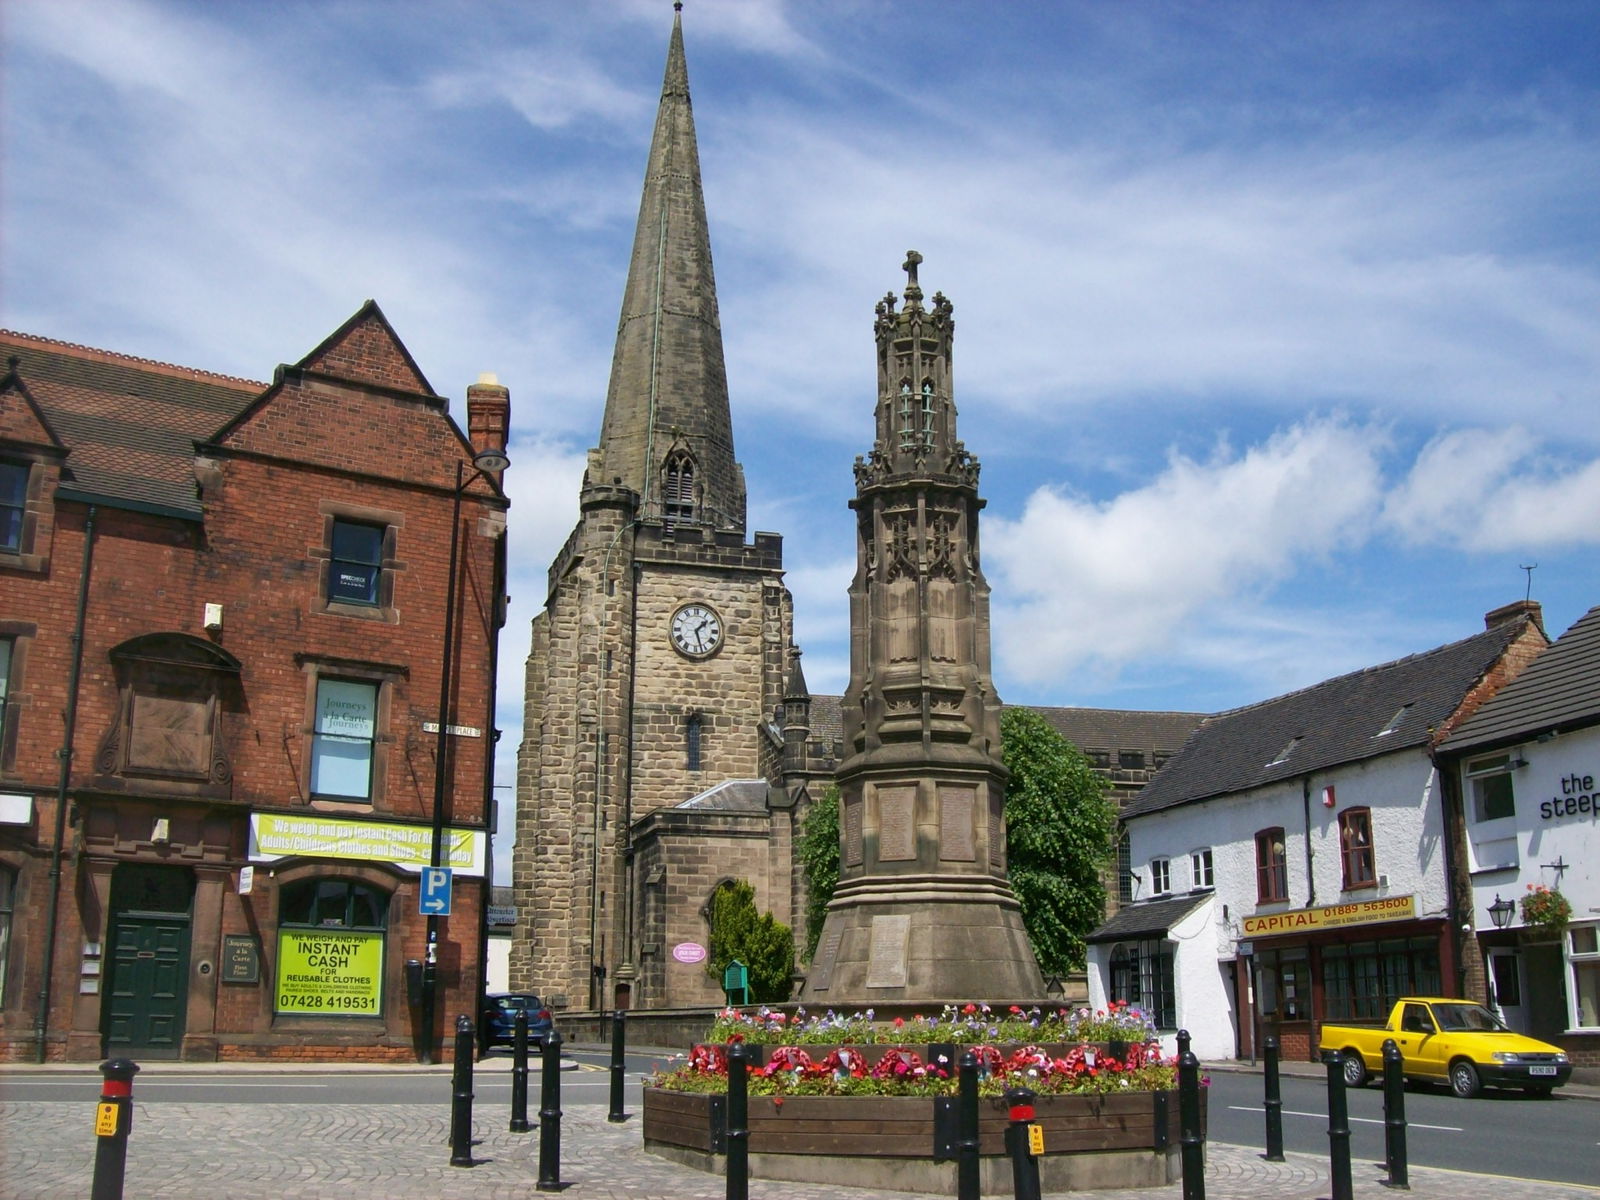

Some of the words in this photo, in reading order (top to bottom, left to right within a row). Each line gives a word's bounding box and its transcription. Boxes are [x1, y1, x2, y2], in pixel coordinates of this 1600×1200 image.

[326, 698, 367, 711] Journeys
[328, 718, 369, 730] Journeys
[342, 712, 367, 723] Carte
[457, 726, 473, 736] PLACE
[1561, 773, 1594, 795] the
[274, 819, 289, 833] We
[290, 821, 318, 836] weigh
[318, 824, 336, 837] and
[337, 826, 354, 839] pay
[354, 826, 385, 841] Instant
[386, 828, 407, 842] Cash
[408, 830, 422, 844] For
[337, 841, 371, 854] Clothes
[372, 843, 389, 856] and
[390, 844, 416, 858] Shoes
[428, 871, 446, 896] P
[1323, 904, 1358, 918] 01889
[1364, 897, 1409, 911] 563600
[1244, 912, 1318, 932] CAPITAL
[1366, 913, 1379, 921] FOOD
[291, 933, 304, 941] WE
[306, 934, 333, 943] WEIGH
[354, 936, 369, 944] PAY
[298, 942, 360, 956] INSTANT
[308, 955, 349, 968] CASH
[320, 967, 337, 976] FOR
[287, 974, 331, 983] REUSABLE
[332, 976, 371, 985] CLOTHES
[280, 995, 323, 1008] 07428
[326, 996, 375, 1009] 419531
